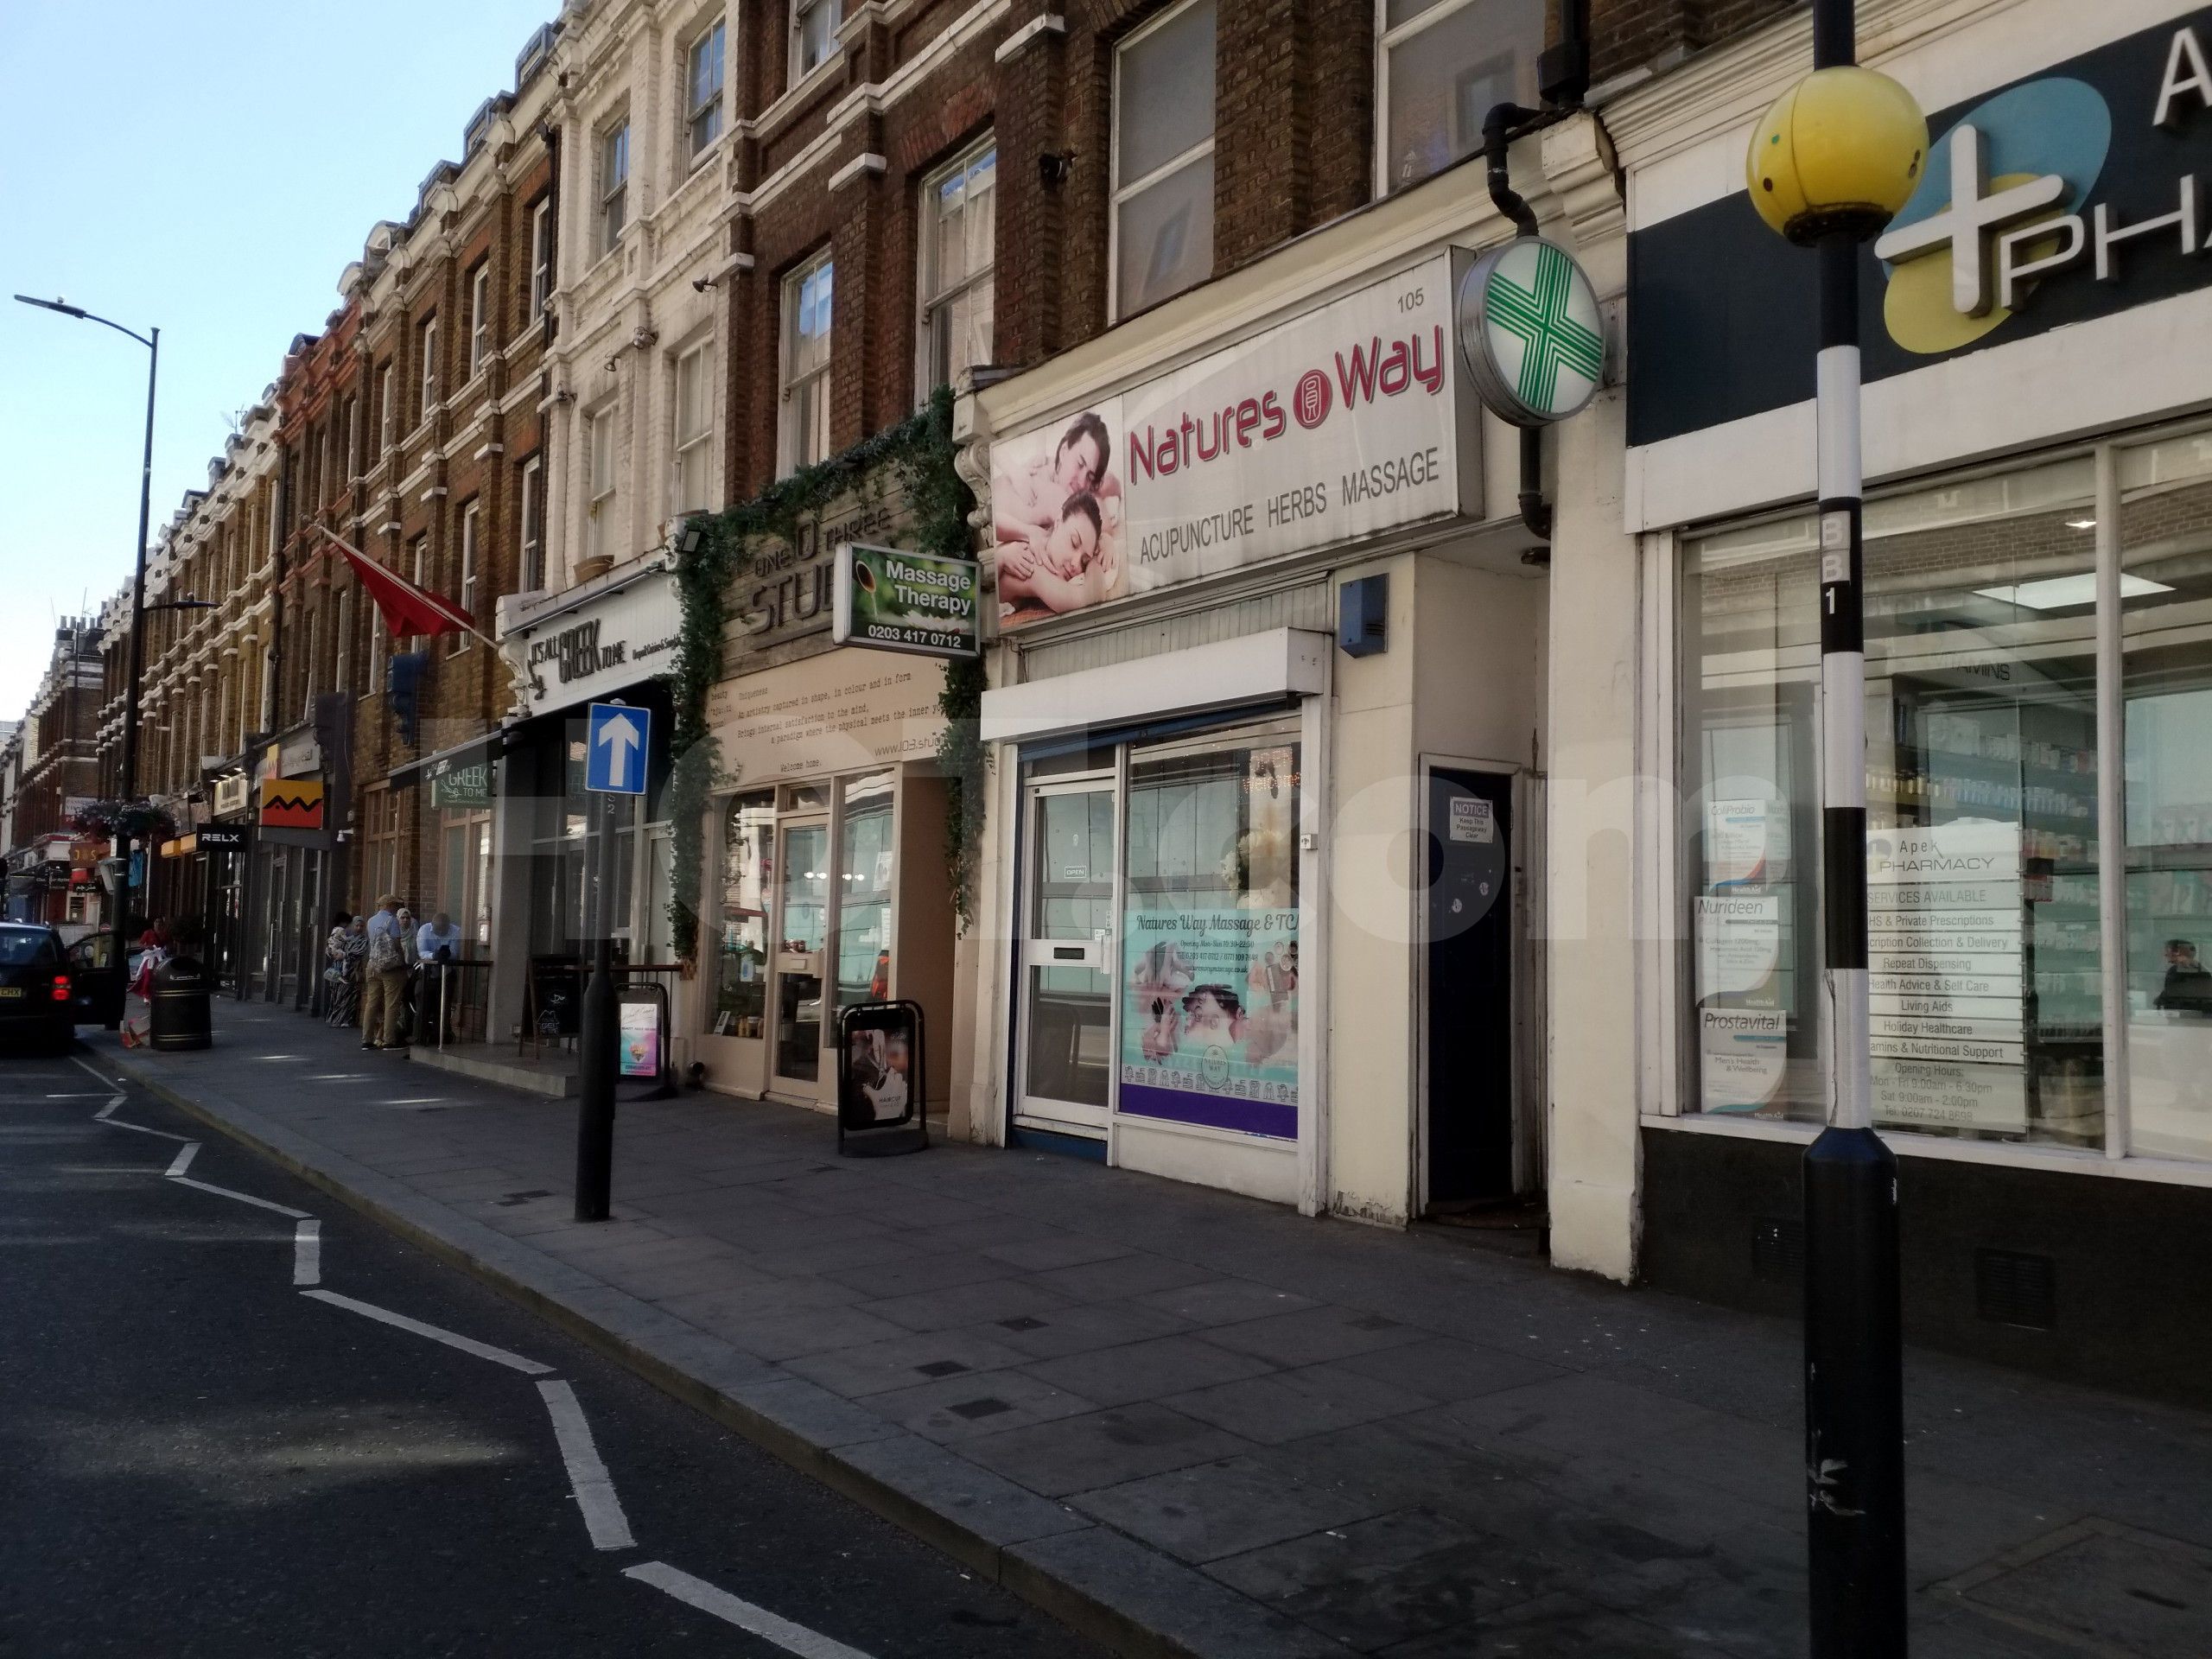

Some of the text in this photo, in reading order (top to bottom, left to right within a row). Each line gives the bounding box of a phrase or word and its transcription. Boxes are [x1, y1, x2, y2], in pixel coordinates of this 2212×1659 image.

[2000, 174, 2212, 308] PH
[1397, 288, 1425, 314] 105
[1130, 324, 1445, 486] Natures Way
[1141, 447, 1440, 564] ACUPUNCTURE HERBS MASSAGE
[886, 560, 971, 593] Massage
[752, 561, 836, 636] STUD
[894, 584, 971, 616] Therapy
[868, 625, 961, 649] 0203 417 0712
[773, 697, 798, 711] captured
[801, 696, 808, 705] in
[811, 691, 830, 703] shape,
[835, 688, 842, 697] in
[844, 683, 867, 696] colour
[869, 678, 881, 690] and
[884, 676, 893, 686] in
[895, 671, 912, 684] form
[785, 712, 824, 728] satisfaction
[827, 710, 835, 720] to
[837, 707, 848, 717] the
[825, 724, 836, 734] the
[838, 716, 868, 732] physical
[871, 713, 890, 725] meets
[893, 709, 906, 721] the
[909, 705, 929, 717] inner
[1455, 803, 1489, 817] NOTICE
[1456, 823, 1487, 833] Passageway
[1459, 817, 1473, 826] Keep
[201, 833, 239, 842] RELX
[1879, 857, 1996, 874] PHARMACY
[1868, 889, 1986, 905] SERVICES AVAILABLE
[1697, 899, 1764, 915] Nurideen
[1136, 914, 1178, 931] Natures
[1180, 914, 1208, 937] Way
[1209, 913, 1262, 938] Massage
[1263, 913, 1274, 930] &
[1869, 915, 1994, 930] HS & Private Prescriptions
[1869, 936, 2009, 951] cription Collection & Delivery
[1883, 957, 1972, 972] Repeat Dispensing
[1899, 980, 1931, 991] Advice
[1934, 980, 1942, 991] &
[1944, 980, 1963, 992] Self
[1966, 981, 1990, 993] Care
[1901, 1000, 1954, 1014] Living Aids
[1704, 1012, 1781, 1030] Prostavital
[1884, 1020, 1974, 1035] Holiday Healthcare
[1870, 1042, 2005, 1059] amins & Nutritional Support
[1895, 1062, 1965, 1077] Opening Hours:
[1880, 1090, 1896, 1102] Sat
